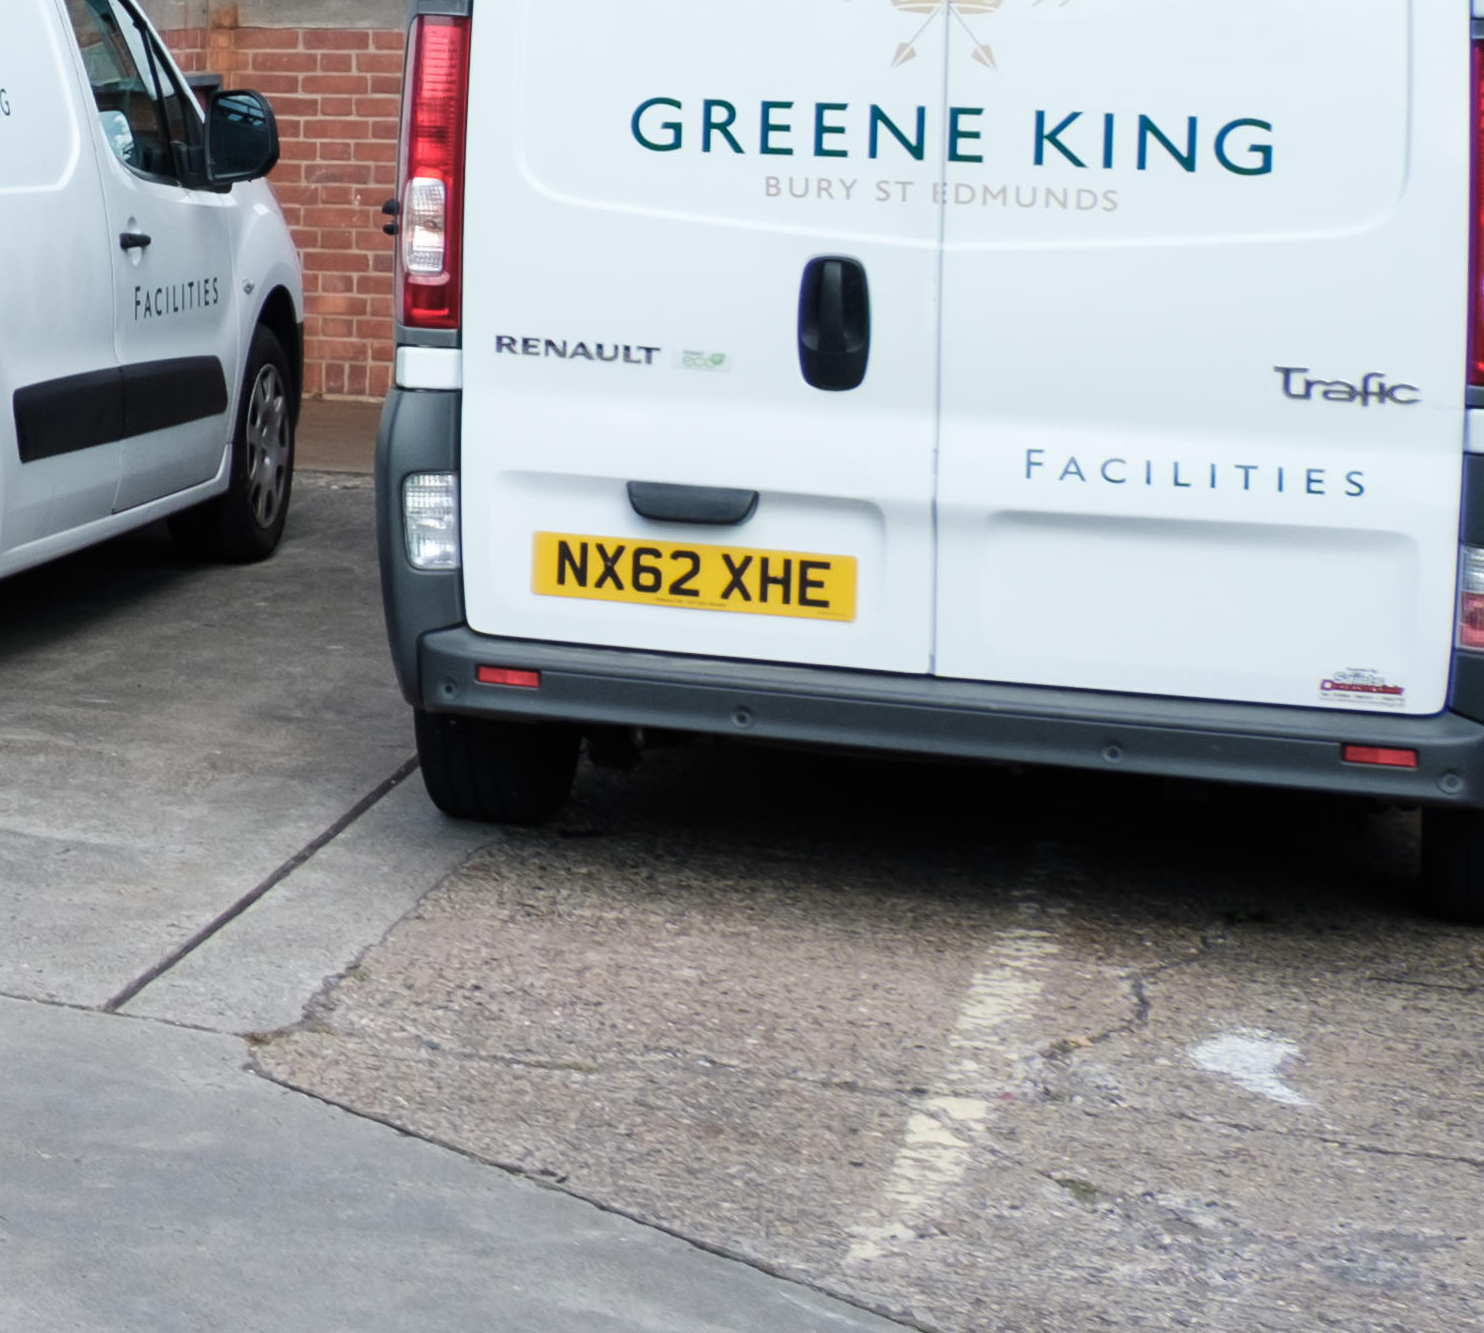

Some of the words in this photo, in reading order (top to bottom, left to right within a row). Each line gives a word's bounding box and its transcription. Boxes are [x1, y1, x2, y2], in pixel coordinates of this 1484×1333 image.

[630, 97, 986, 164] GREENE
[1033, 109, 1274, 177] KING
[764, 175, 859, 201] BURY
[874, 179, 915, 204] ST
[931, 181, 1120, 213] EDMUNDS
[134, 276, 219, 321] FACILITIES
[494, 334, 660, 366] RENAULT
[1273, 366, 1422, 407] Trafic
[1024, 448, 1366, 497] FACILITIES
[557, 540, 701, 598] NX62
[720, 553, 831, 609] XHE
